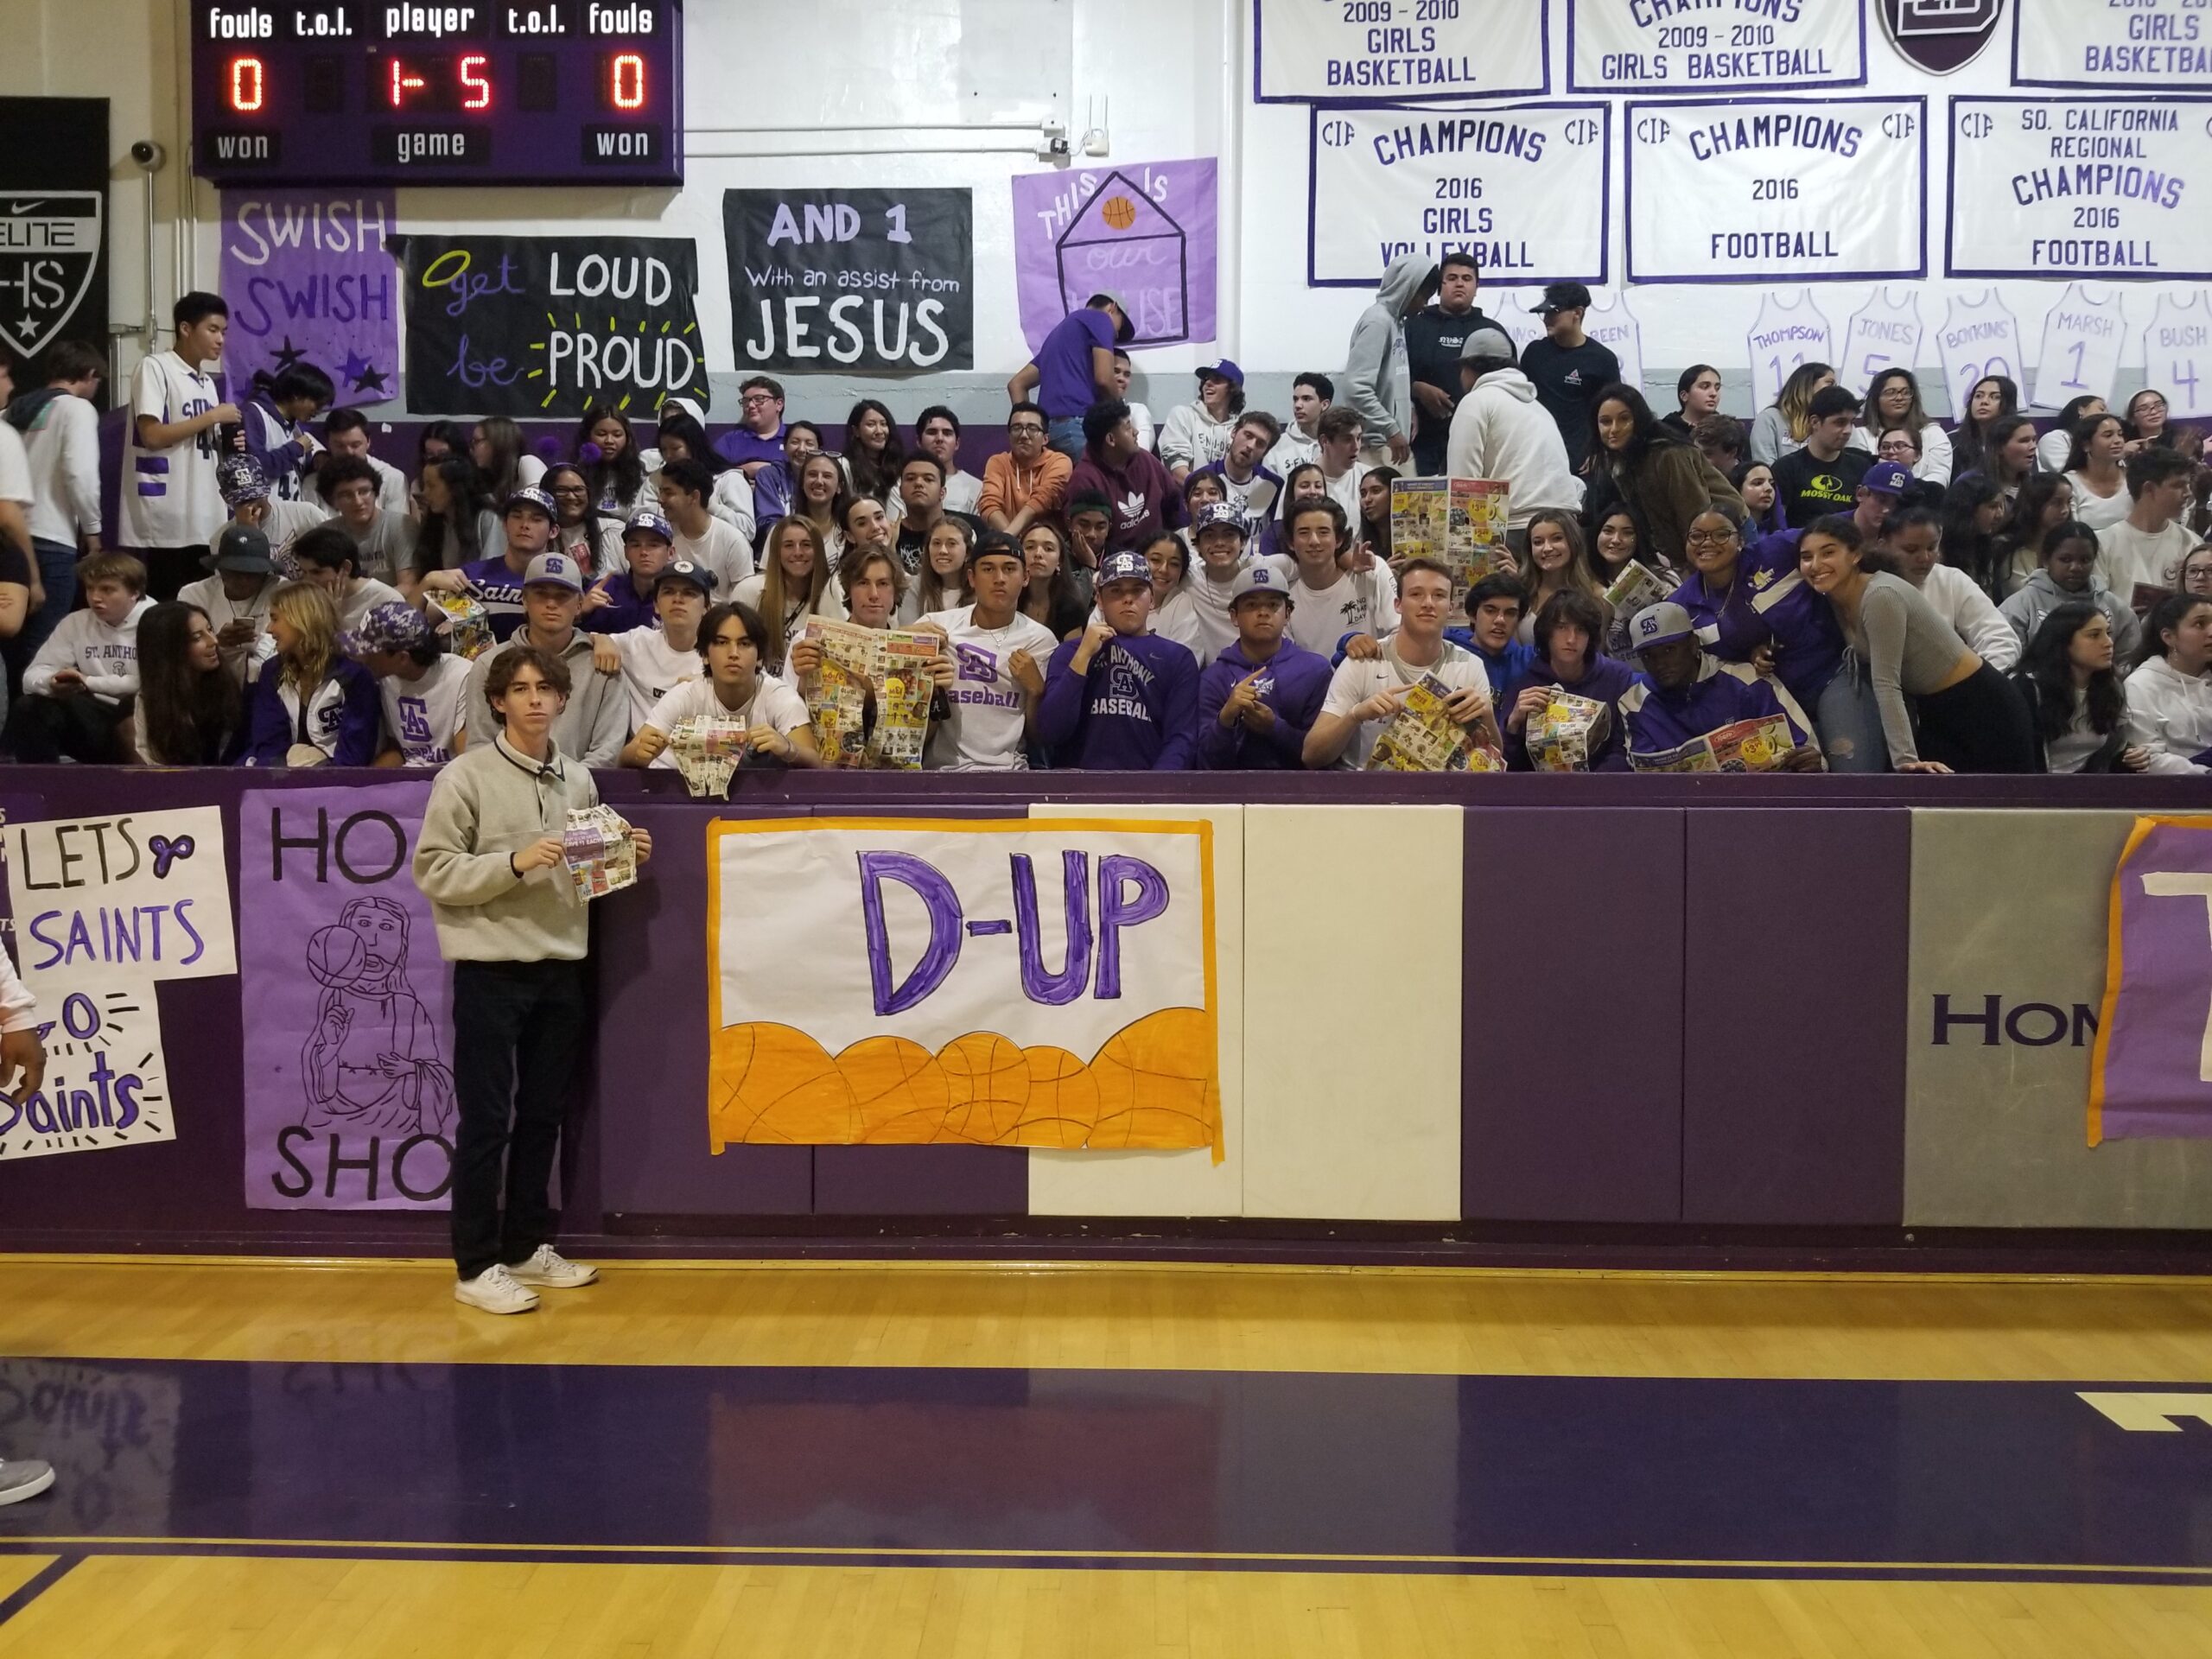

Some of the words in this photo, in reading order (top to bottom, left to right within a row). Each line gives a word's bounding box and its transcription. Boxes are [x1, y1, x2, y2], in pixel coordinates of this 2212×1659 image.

[210, 8, 272, 39] fouls
[296, 9, 353, 36] t.o.l.
[386, 2, 474, 36] player
[508, 5, 565, 34] t.o.l.
[589, 3, 653, 34] fouls
[1344, 2, 1391, 22] 2009
[1416, 0, 1459, 21] 2010
[1368, 27, 1436, 54] GIRLS
[1658, 27, 1707, 48] 2009
[1731, 25, 1774, 47] 2010
[2129, 14, 2200, 41] GIRLS
[1327, 56, 1477, 86] BASKETBALL
[1602, 54, 1668, 80] GIRLS
[1688, 48, 1832, 79] BASKETBALL
[2085, 45, 2212, 73] BASKETBA
[232, 57, 263, 111] 0
[613, 54, 644, 110] 0
[2021, 109, 2052, 130] SO.
[2065, 109, 2179, 131] CALIFORNIA
[218, 135, 269, 159] won
[397, 130, 466, 163] game
[596, 132, 649, 156] won
[1373, 119, 1547, 166] CHAMPIONS
[1688, 114, 1863, 161] CHAMPIONS
[2050, 137, 2147, 158] REGIONAL
[1435, 178, 1483, 199] 2016
[1751, 178, 1799, 200] 2016
[2012, 163, 2185, 209] CHAMPIONS
[1037, 172, 1098, 241] THIS
[1144, 166, 1168, 203] IS
[2073, 207, 2120, 228] 2016
[0, 222, 76, 246] LITE
[231, 199, 386, 265] SWISH
[766, 202, 861, 247] AND
[885, 203, 912, 244] 1
[1423, 207, 1493, 233] GIRLS
[1711, 231, 1839, 258] FOOTBALL
[2032, 239, 2158, 267] FOOTBALL
[446, 253, 526, 316] get
[550, 251, 672, 307] LOUD
[745, 264, 794, 287] With
[803, 269, 827, 287] an
[837, 268, 900, 289] assist
[908, 268, 960, 294] from
[234, 273, 388, 337] SWISH
[747, 295, 950, 367] JESUS
[1752, 325, 1826, 350] THOMPSON
[1858, 317, 1915, 346] JONES
[2056, 312, 2114, 339] MARSH
[2159, 325, 2208, 346] BUSH
[446, 333, 525, 388] be
[550, 330, 695, 390] PROUD
[2172, 359, 2201, 409] 4
[1801, 489, 1833, 500] MOSSY
[1833, 493, 1853, 503] OAK
[469, 578, 524, 603] Sain
[103, 644, 138, 660] ANTHO
[948, 686, 1020, 709] aseball
[20, 817, 141, 890] LETS
[270, 807, 408, 885] HO
[29, 899, 205, 969] SAINTS
[855, 849, 1171, 1017] D-UP
[1930, 993, 2099, 1047] HON
[270, 1124, 456, 1203] SHO
